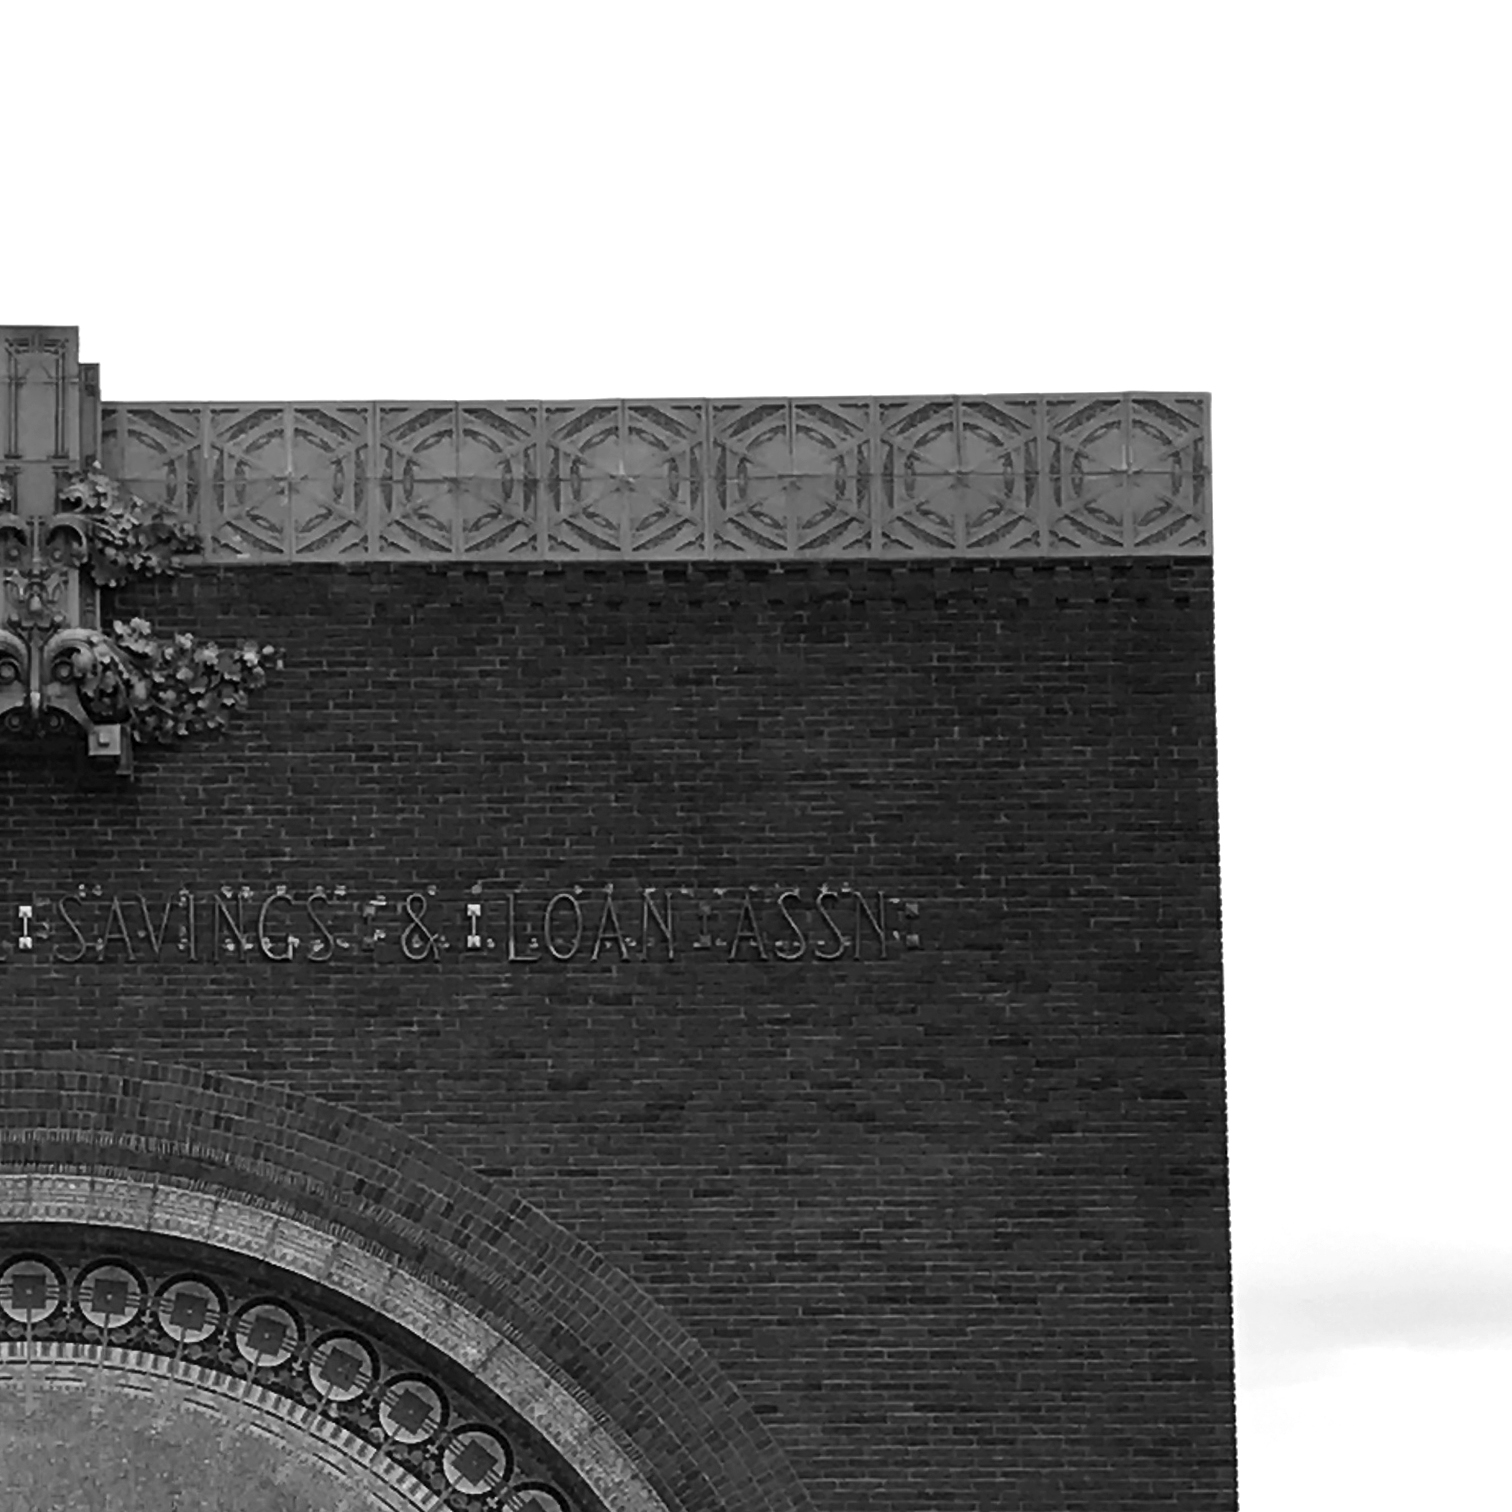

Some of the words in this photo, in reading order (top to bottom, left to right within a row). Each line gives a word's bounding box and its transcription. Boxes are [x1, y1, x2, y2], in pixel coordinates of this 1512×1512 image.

[53, 892, 337, 963] SAVINGS
[400, 892, 441, 960] &
[506, 891, 676, 962] LOAN
[727, 890, 888, 961] ASSN
